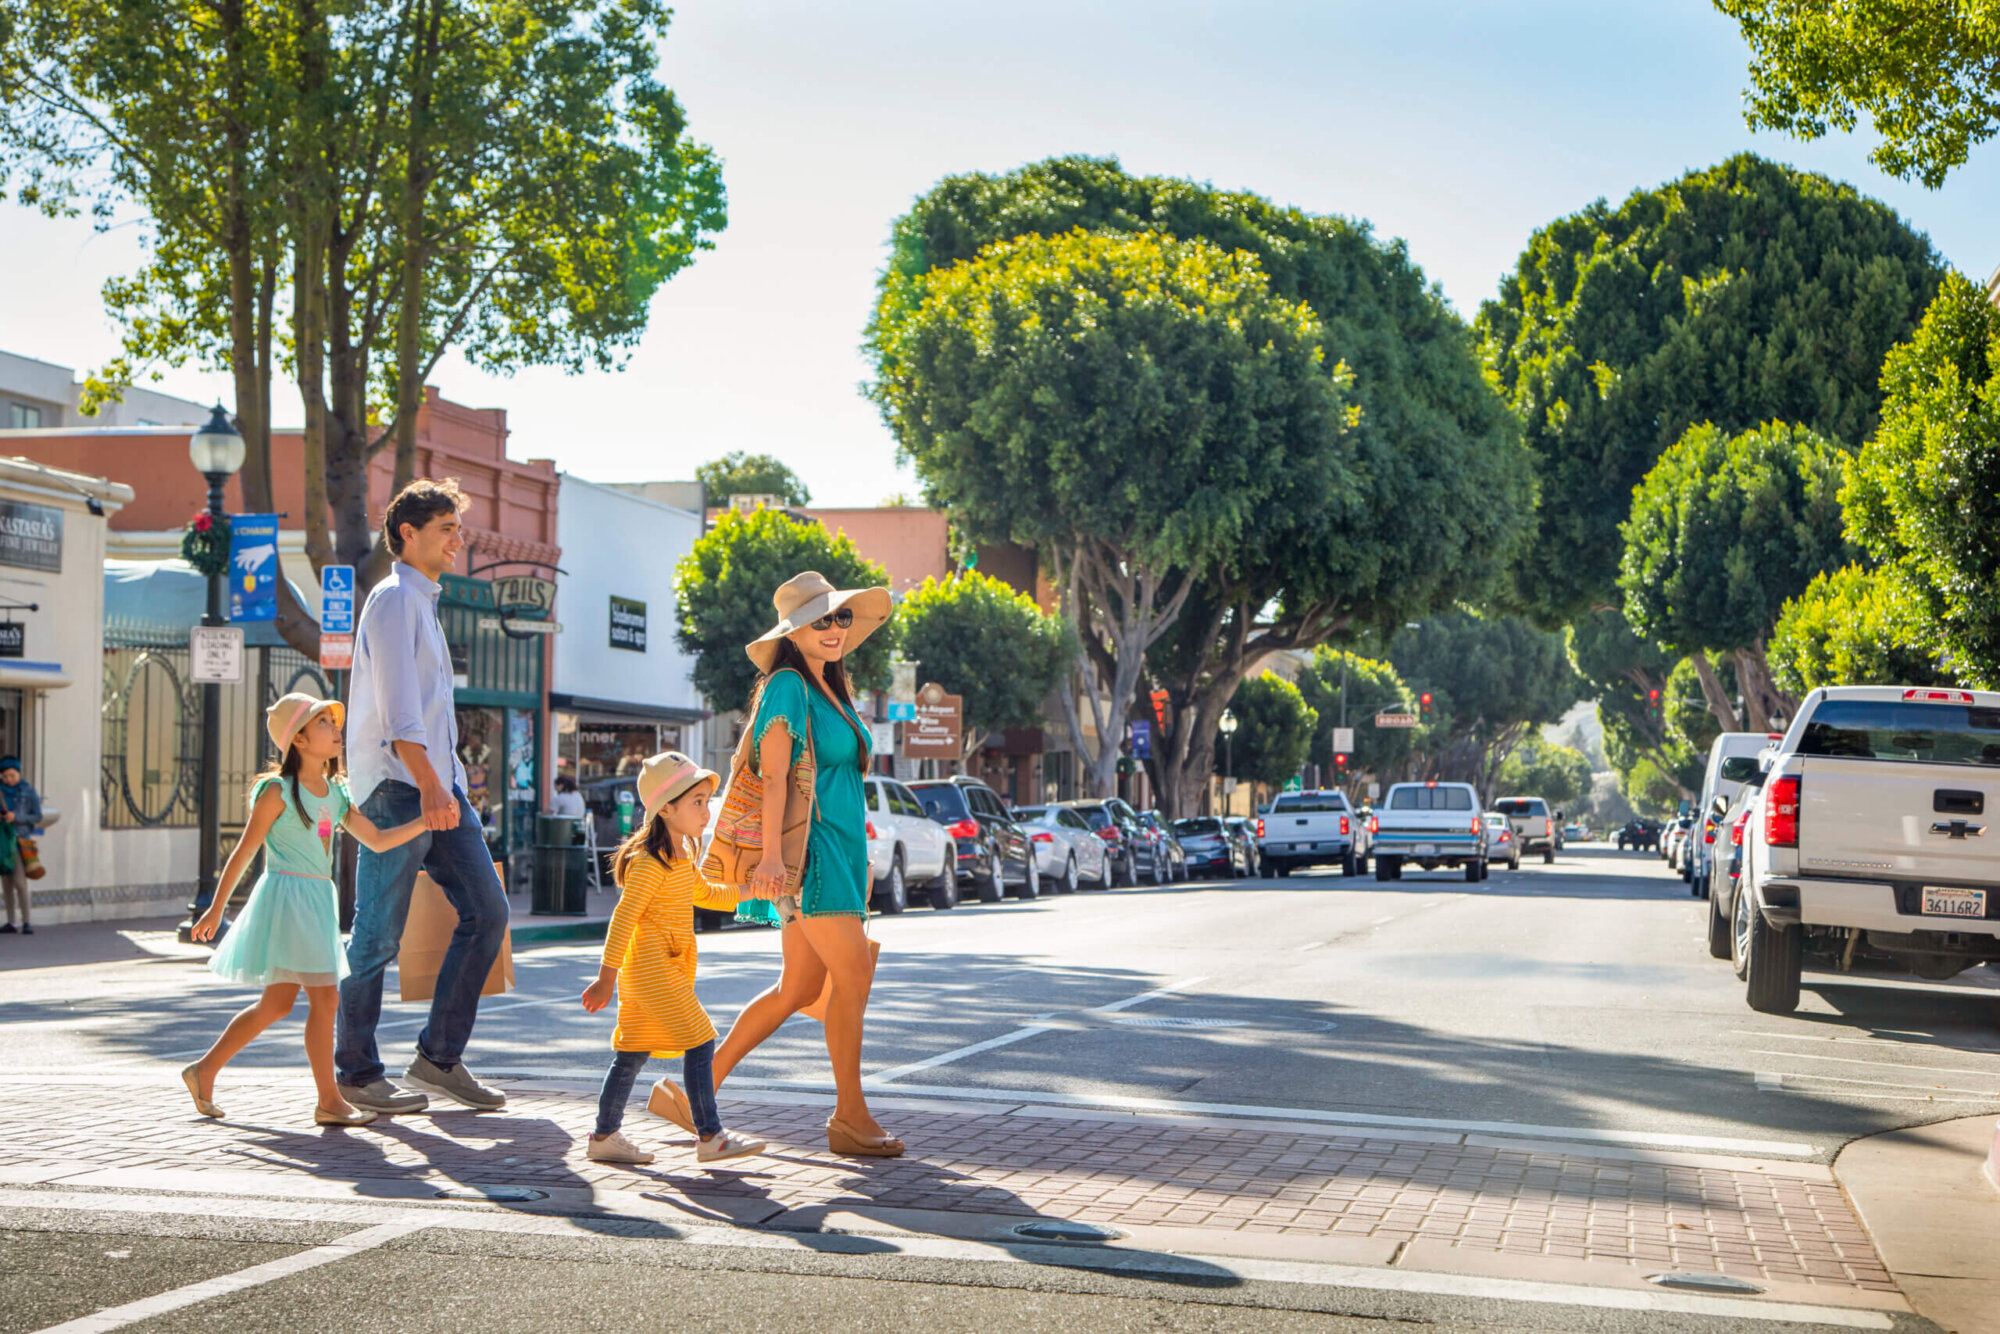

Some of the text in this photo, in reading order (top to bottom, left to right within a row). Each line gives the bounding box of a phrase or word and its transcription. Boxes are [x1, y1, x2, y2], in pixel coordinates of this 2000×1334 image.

[496, 579, 546, 606] TAILS
[1380, 716, 1413, 725] BROAD
[1926, 898, 1980, 914] 36116R2
